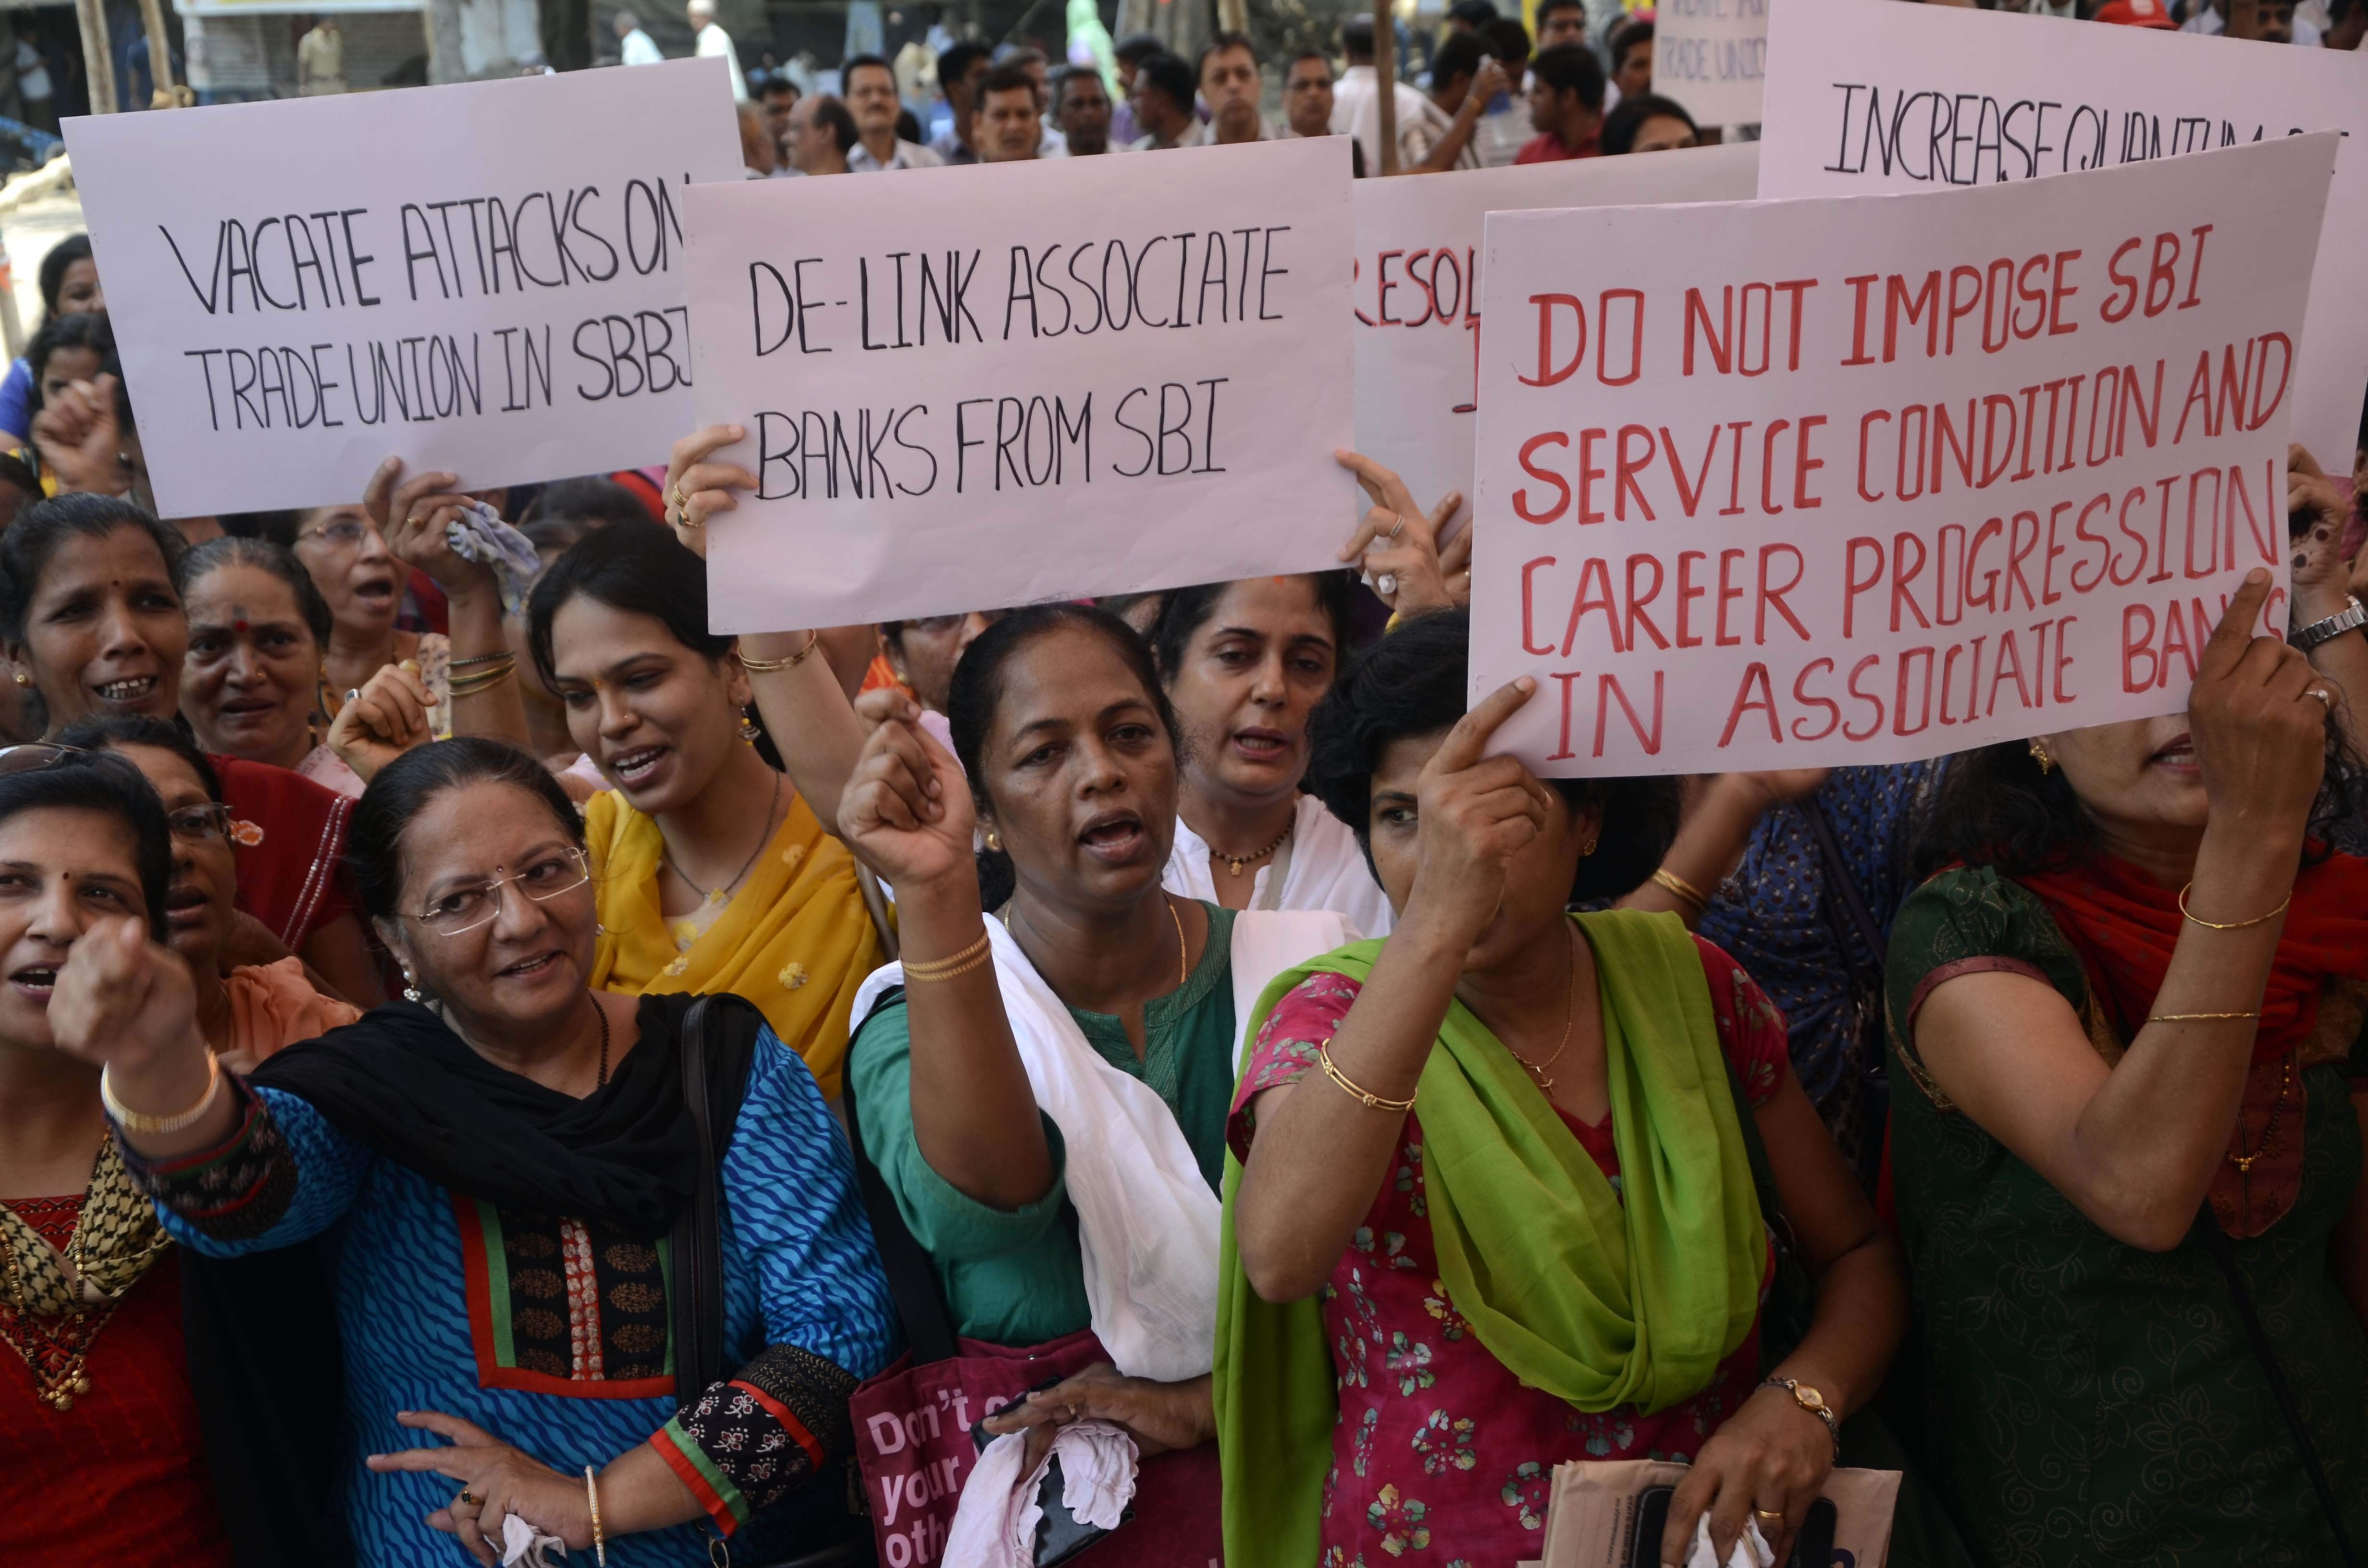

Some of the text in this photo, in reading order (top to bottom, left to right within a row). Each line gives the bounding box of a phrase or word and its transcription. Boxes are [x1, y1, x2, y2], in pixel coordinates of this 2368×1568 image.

[1660, 36, 1709, 80] TRADE
[1824, 83, 2062, 186] INCREASE
[159, 172, 690, 314] VACATE ATTACKS ON
[749, 226, 1291, 356] DE-LINK ASSOCIATE
[1511, 288, 1646, 387] DO
[1683, 279, 1818, 378] NOT
[1840, 249, 2083, 365] IMPOSE
[2099, 224, 2213, 324] SBI
[185, 306, 692, 431] TRADE UNION IN SBBJ
[1512, 331, 2293, 527] SERVICE CONDITION AND
[754, 378, 1229, 500] BANKS FROM SBI
[1521, 459, 2279, 658] CAREER PROGRESSION
[1545, 587, 2285, 762] IN ASSOCIATE BANS
[867, 1388, 971, 1455] Don't
[881, 1456, 960, 1526] your
